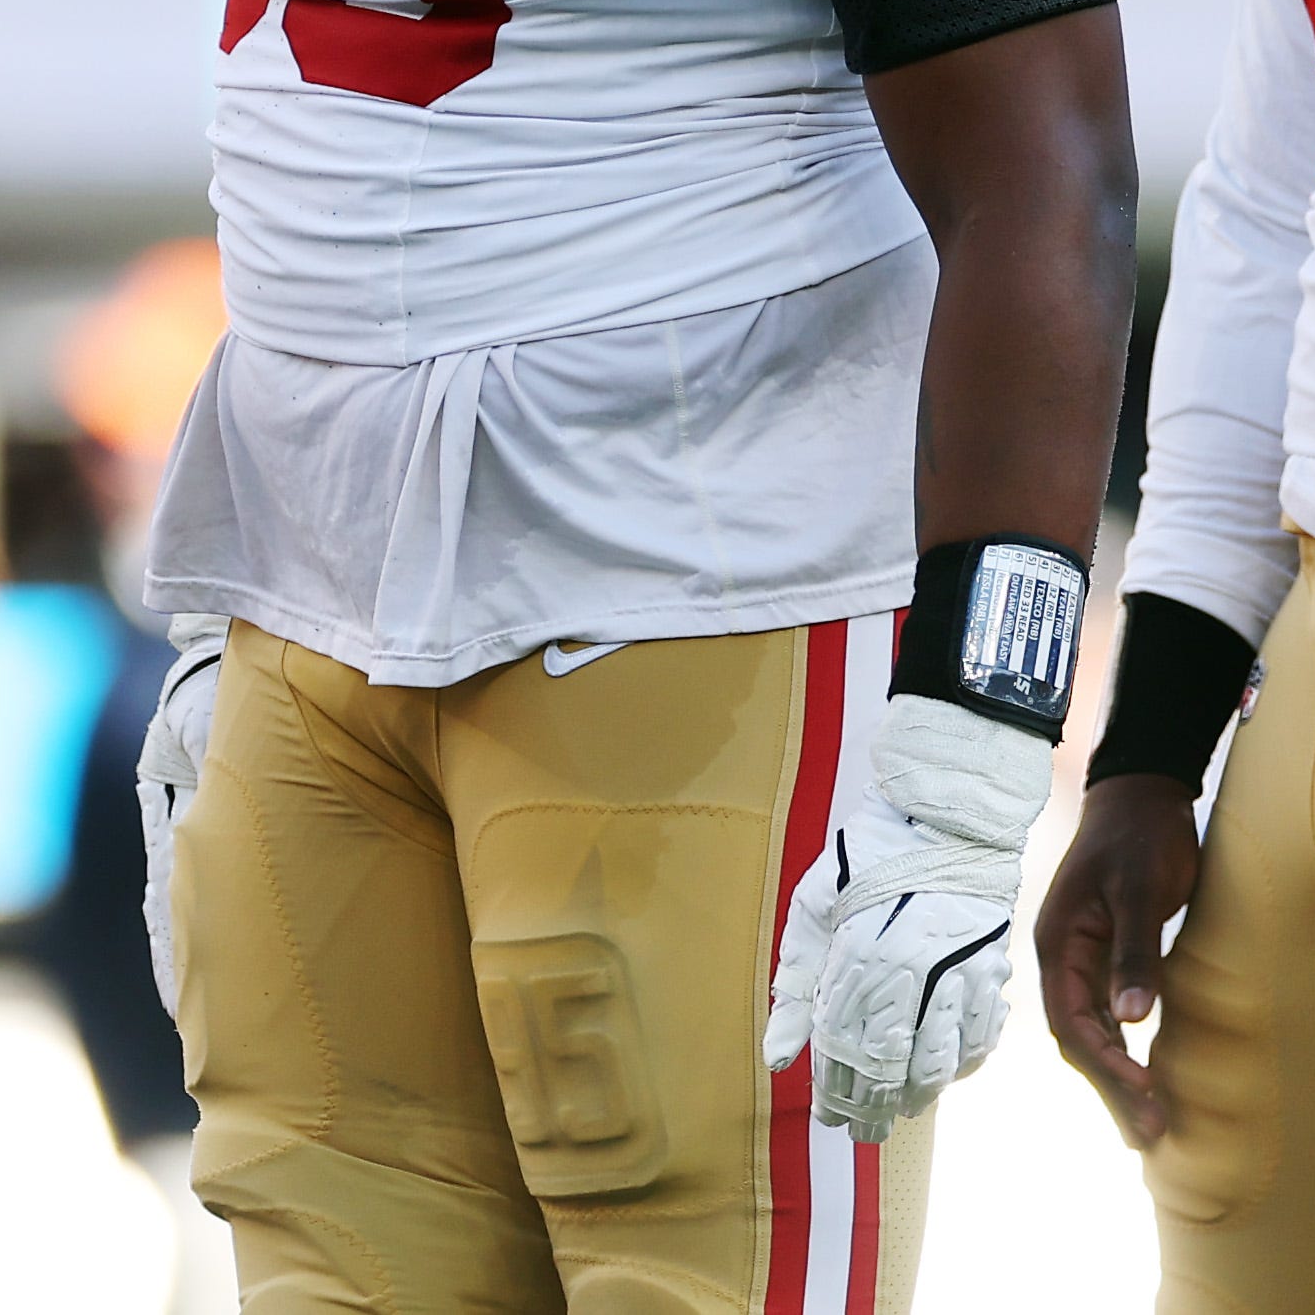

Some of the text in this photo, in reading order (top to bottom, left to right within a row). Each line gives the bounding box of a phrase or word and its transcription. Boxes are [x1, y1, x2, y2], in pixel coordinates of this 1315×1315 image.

[980, 570, 993, 600] TESLA
[1007, 574, 1020, 614] OUTLAW
[1023, 578, 1034, 599] RED
[1020, 601, 1030, 613] 33
[1033, 582, 1046, 618] TEXICO
[1043, 600, 1056, 622] (RB)
[1057, 591, 1068, 617] TEAR
[1067, 595, 1077, 620] EASY
[1016, 614, 1028, 642] READ
[1027, 618, 1040, 641] (RB)
[1052, 617, 1064, 640] (RB)
[1063, 622, 1072, 643] (RB)
